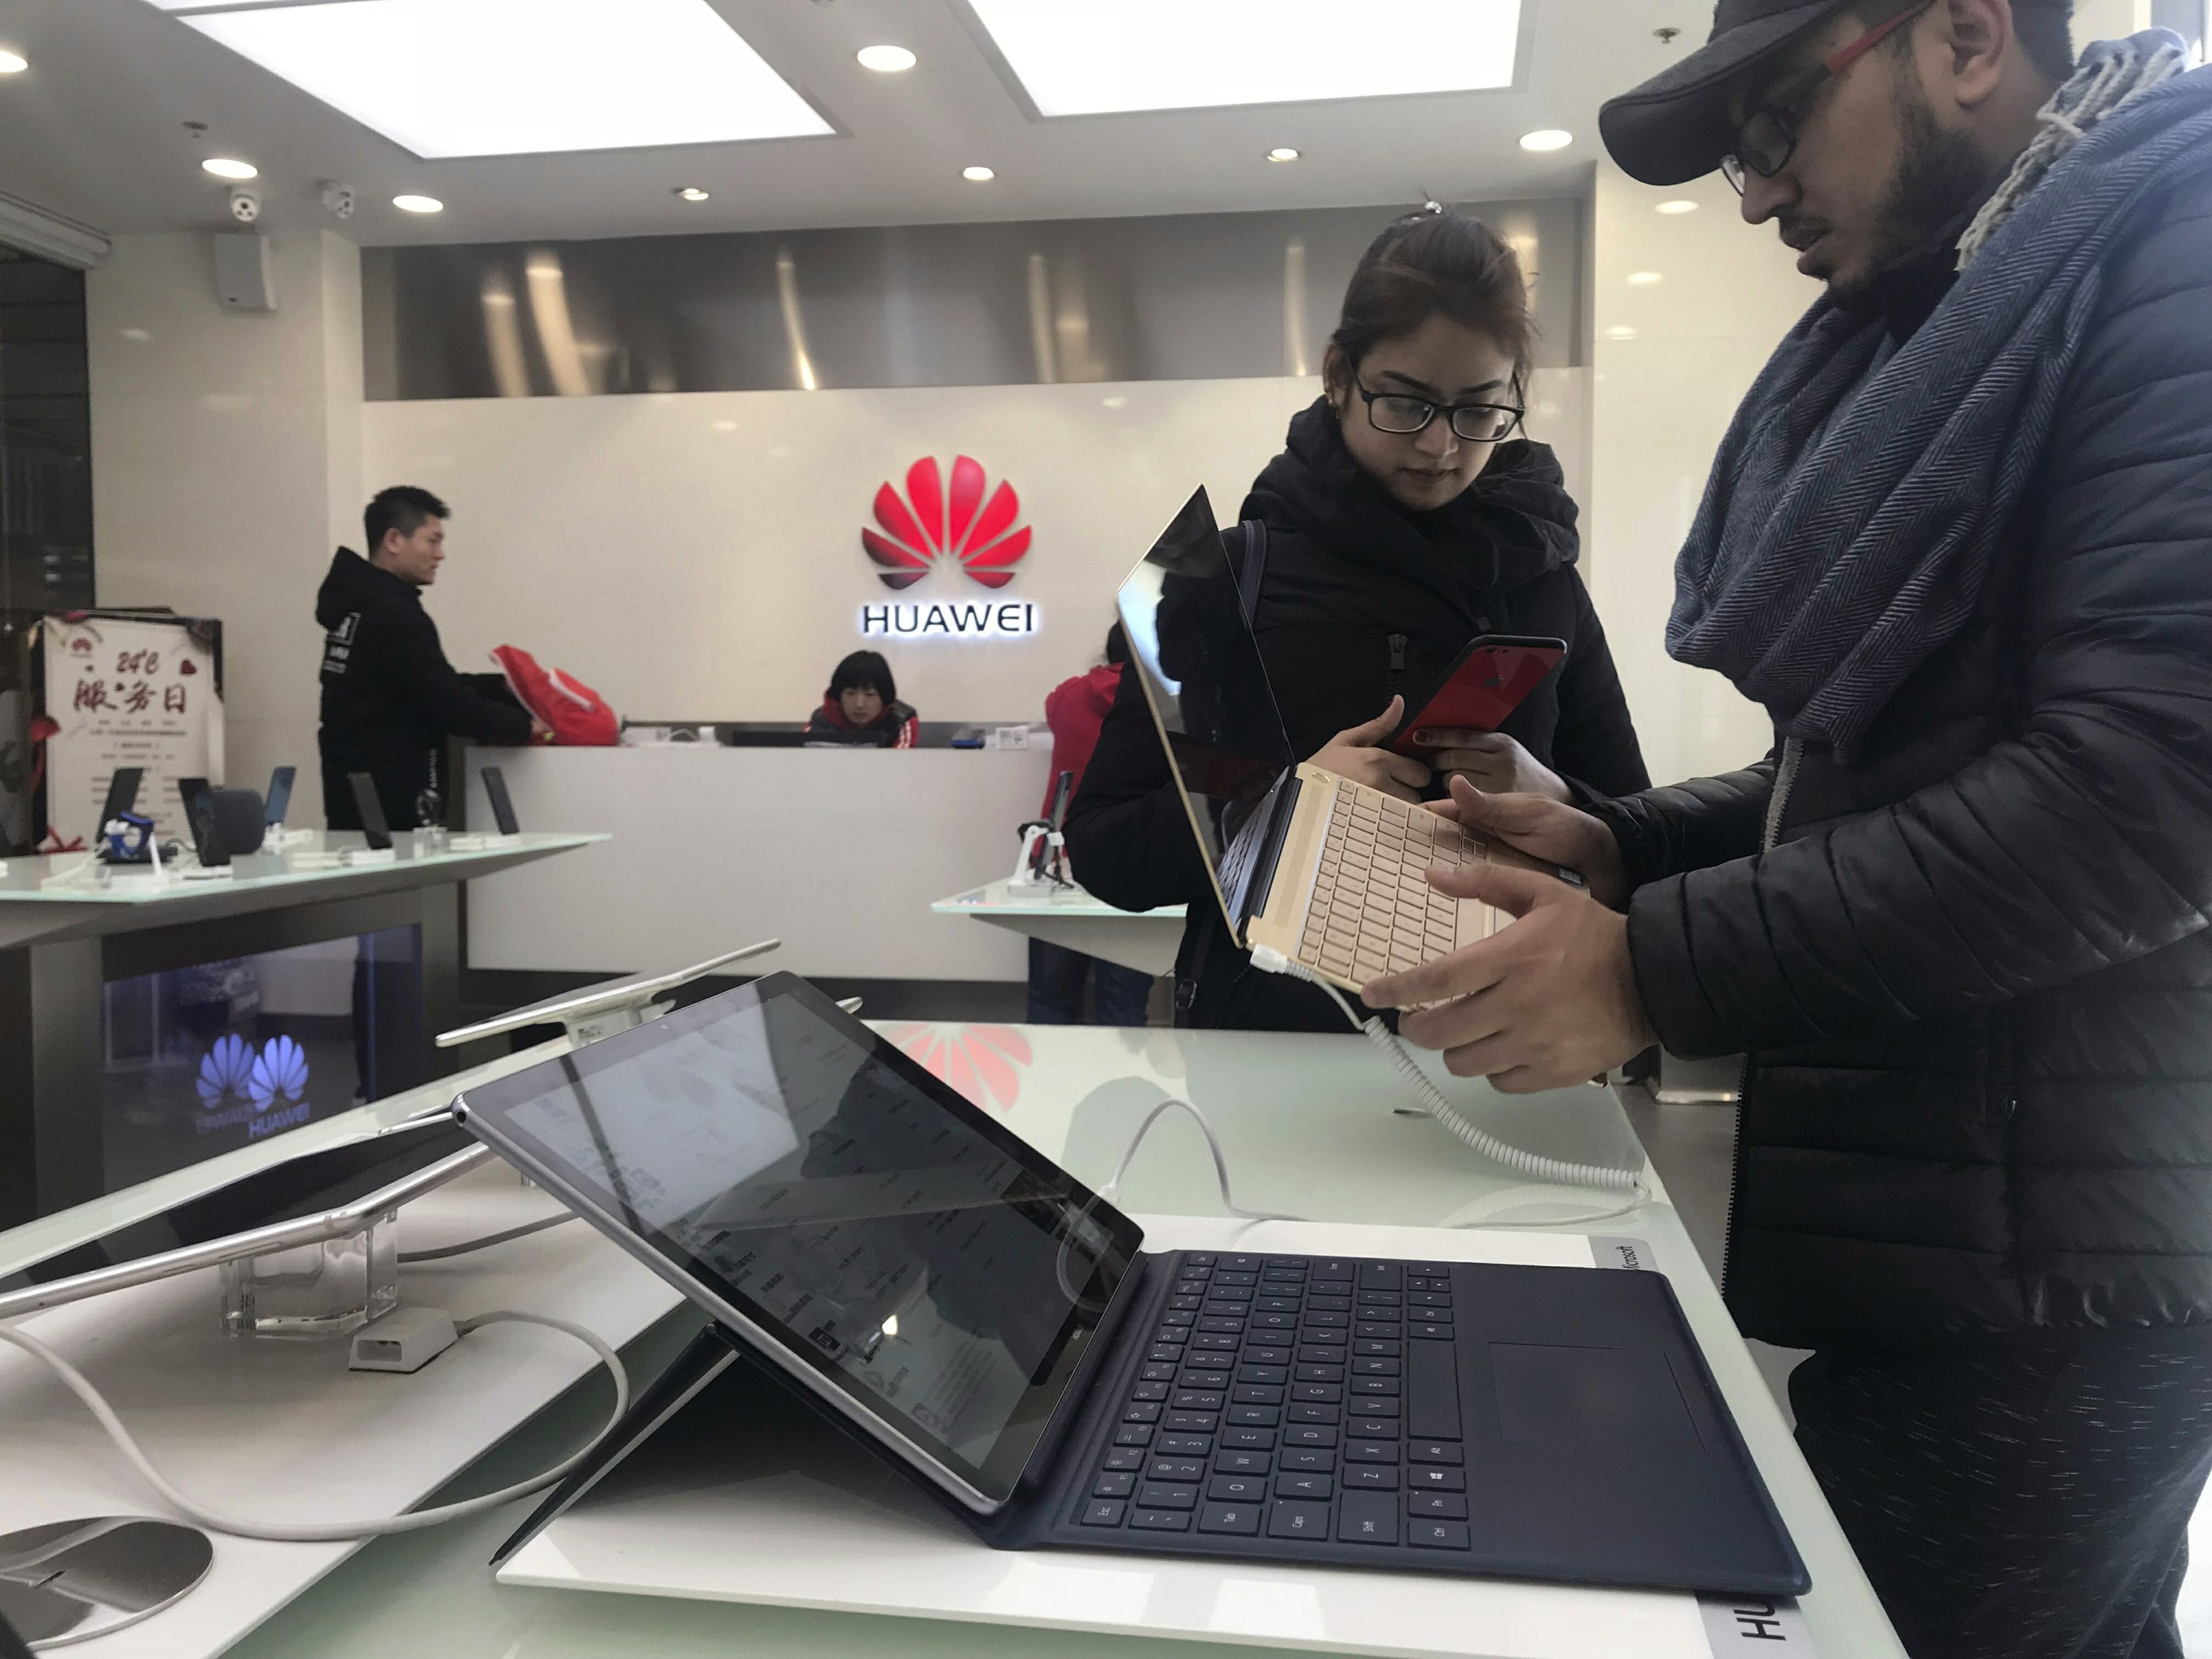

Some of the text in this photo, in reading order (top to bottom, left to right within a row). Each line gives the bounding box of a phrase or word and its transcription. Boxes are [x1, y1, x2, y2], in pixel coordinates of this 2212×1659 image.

[862, 603, 1033, 633] HUAWEI
[73, 678, 187, 714] 服务日
